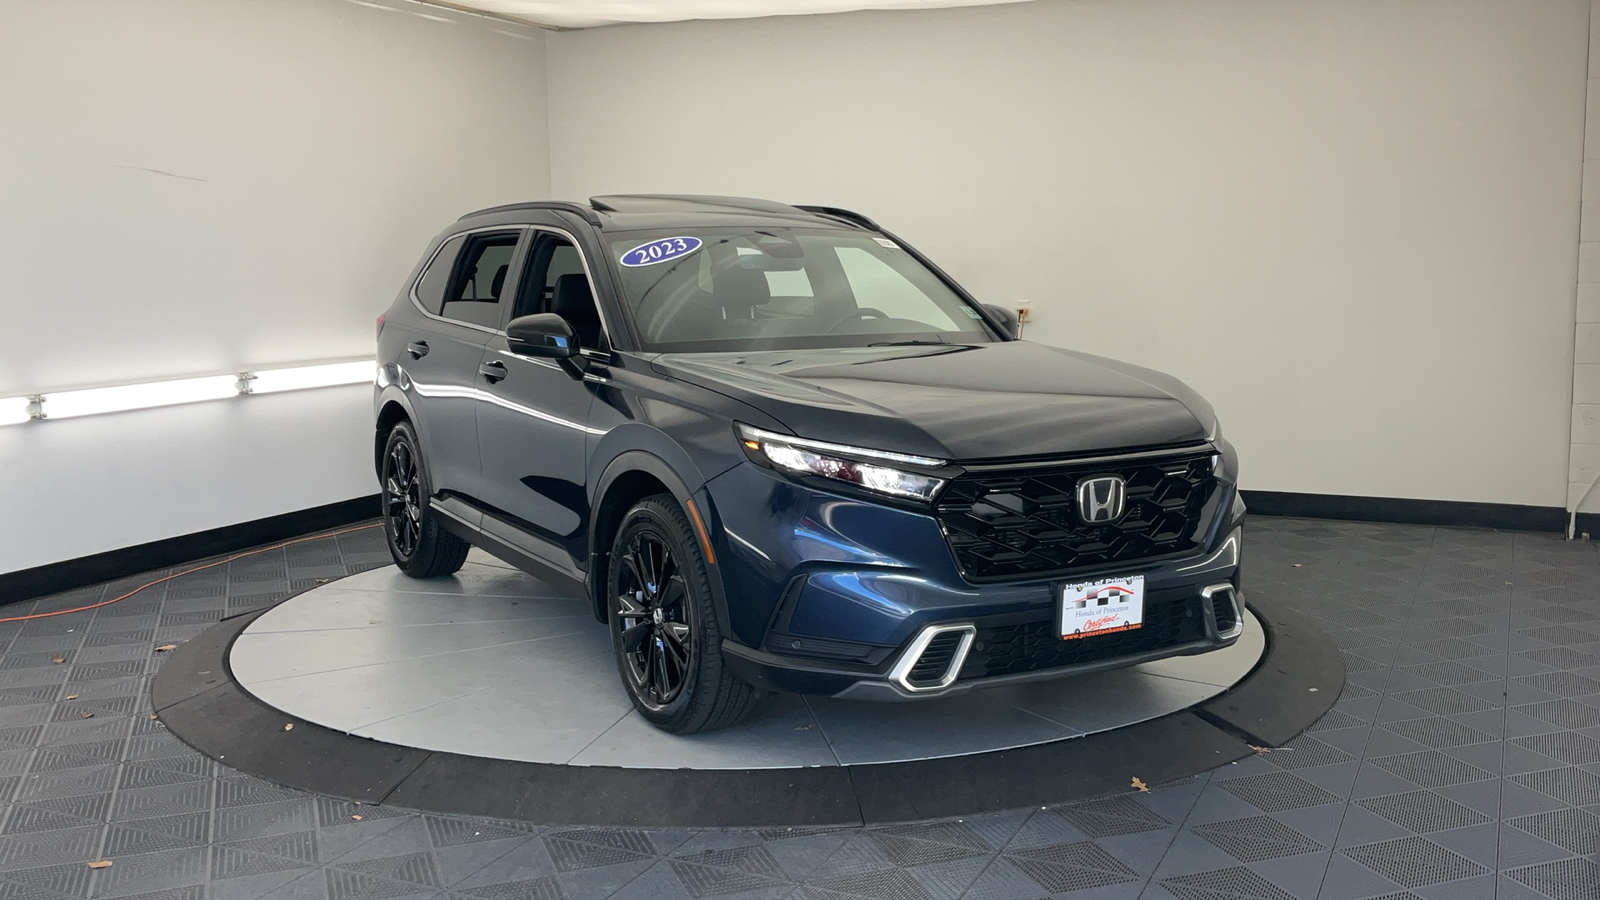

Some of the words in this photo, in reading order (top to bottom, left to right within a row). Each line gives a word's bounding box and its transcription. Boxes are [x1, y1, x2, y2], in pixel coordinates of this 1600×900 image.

[635, 239, 687, 263] 2023
[1075, 609, 1094, 618] Honda
[1103, 606, 1129, 614] Princeton
